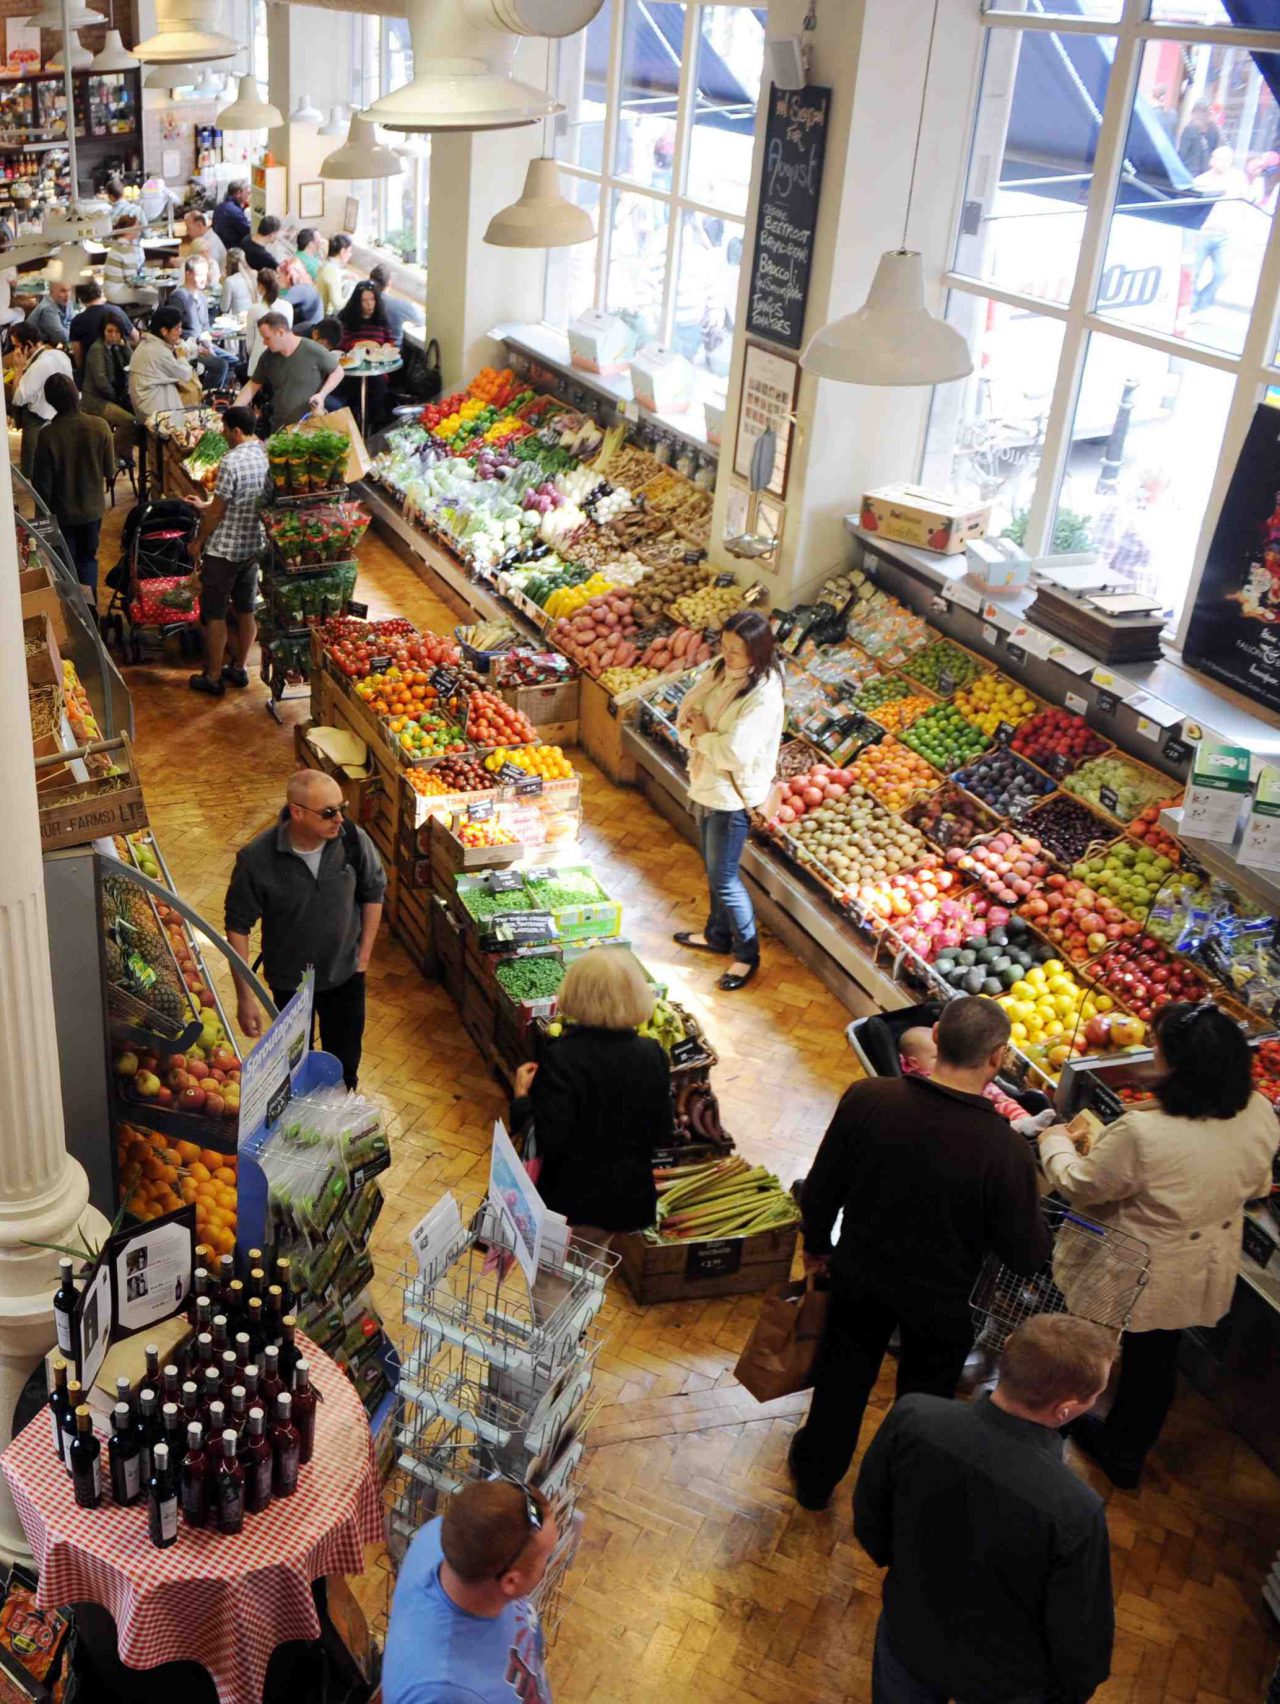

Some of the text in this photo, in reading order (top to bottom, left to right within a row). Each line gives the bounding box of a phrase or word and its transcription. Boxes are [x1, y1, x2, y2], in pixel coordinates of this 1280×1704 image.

[767, 137, 817, 197] August
[68, 810, 115, 832] FARMS)
[6, 1609, 54, 1650] BBQ
